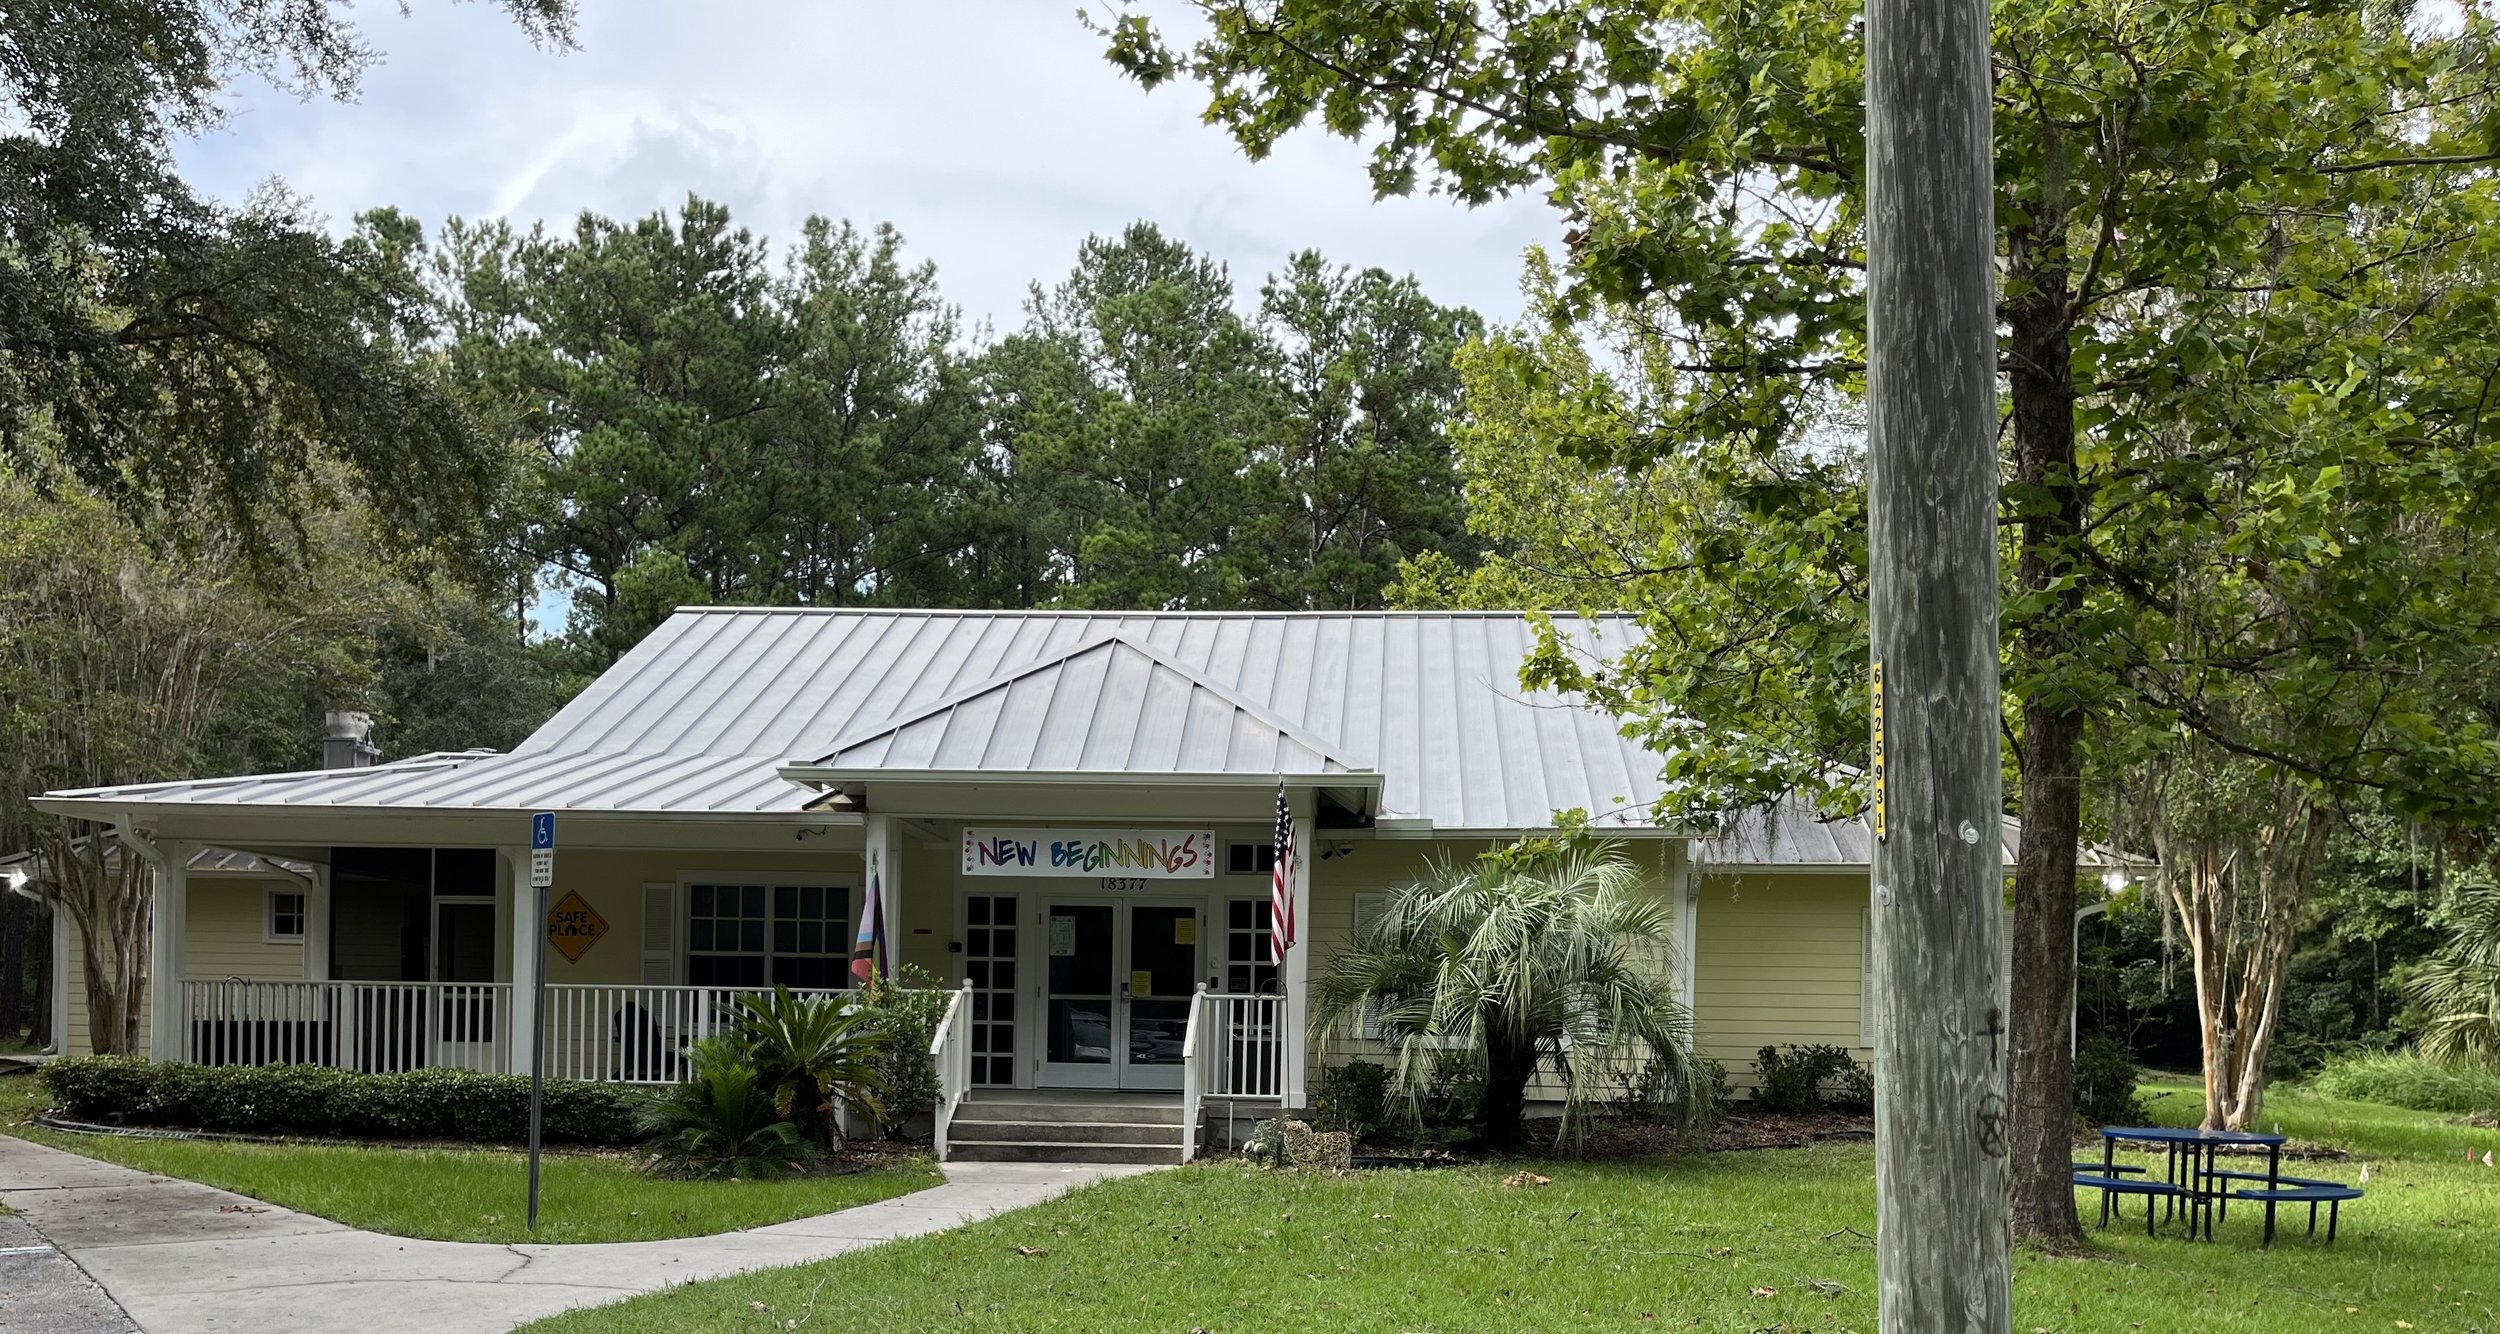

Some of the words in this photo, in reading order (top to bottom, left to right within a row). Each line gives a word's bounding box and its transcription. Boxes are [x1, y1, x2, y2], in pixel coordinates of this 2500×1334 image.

[1873, 668, 1884, 828] 6225931
[978, 837, 1037, 867] NEW
[1050, 834, 1198, 874] BEGINNINGS
[1101, 877, 1148, 891] 18377
[556, 911, 587, 923] SAFE
